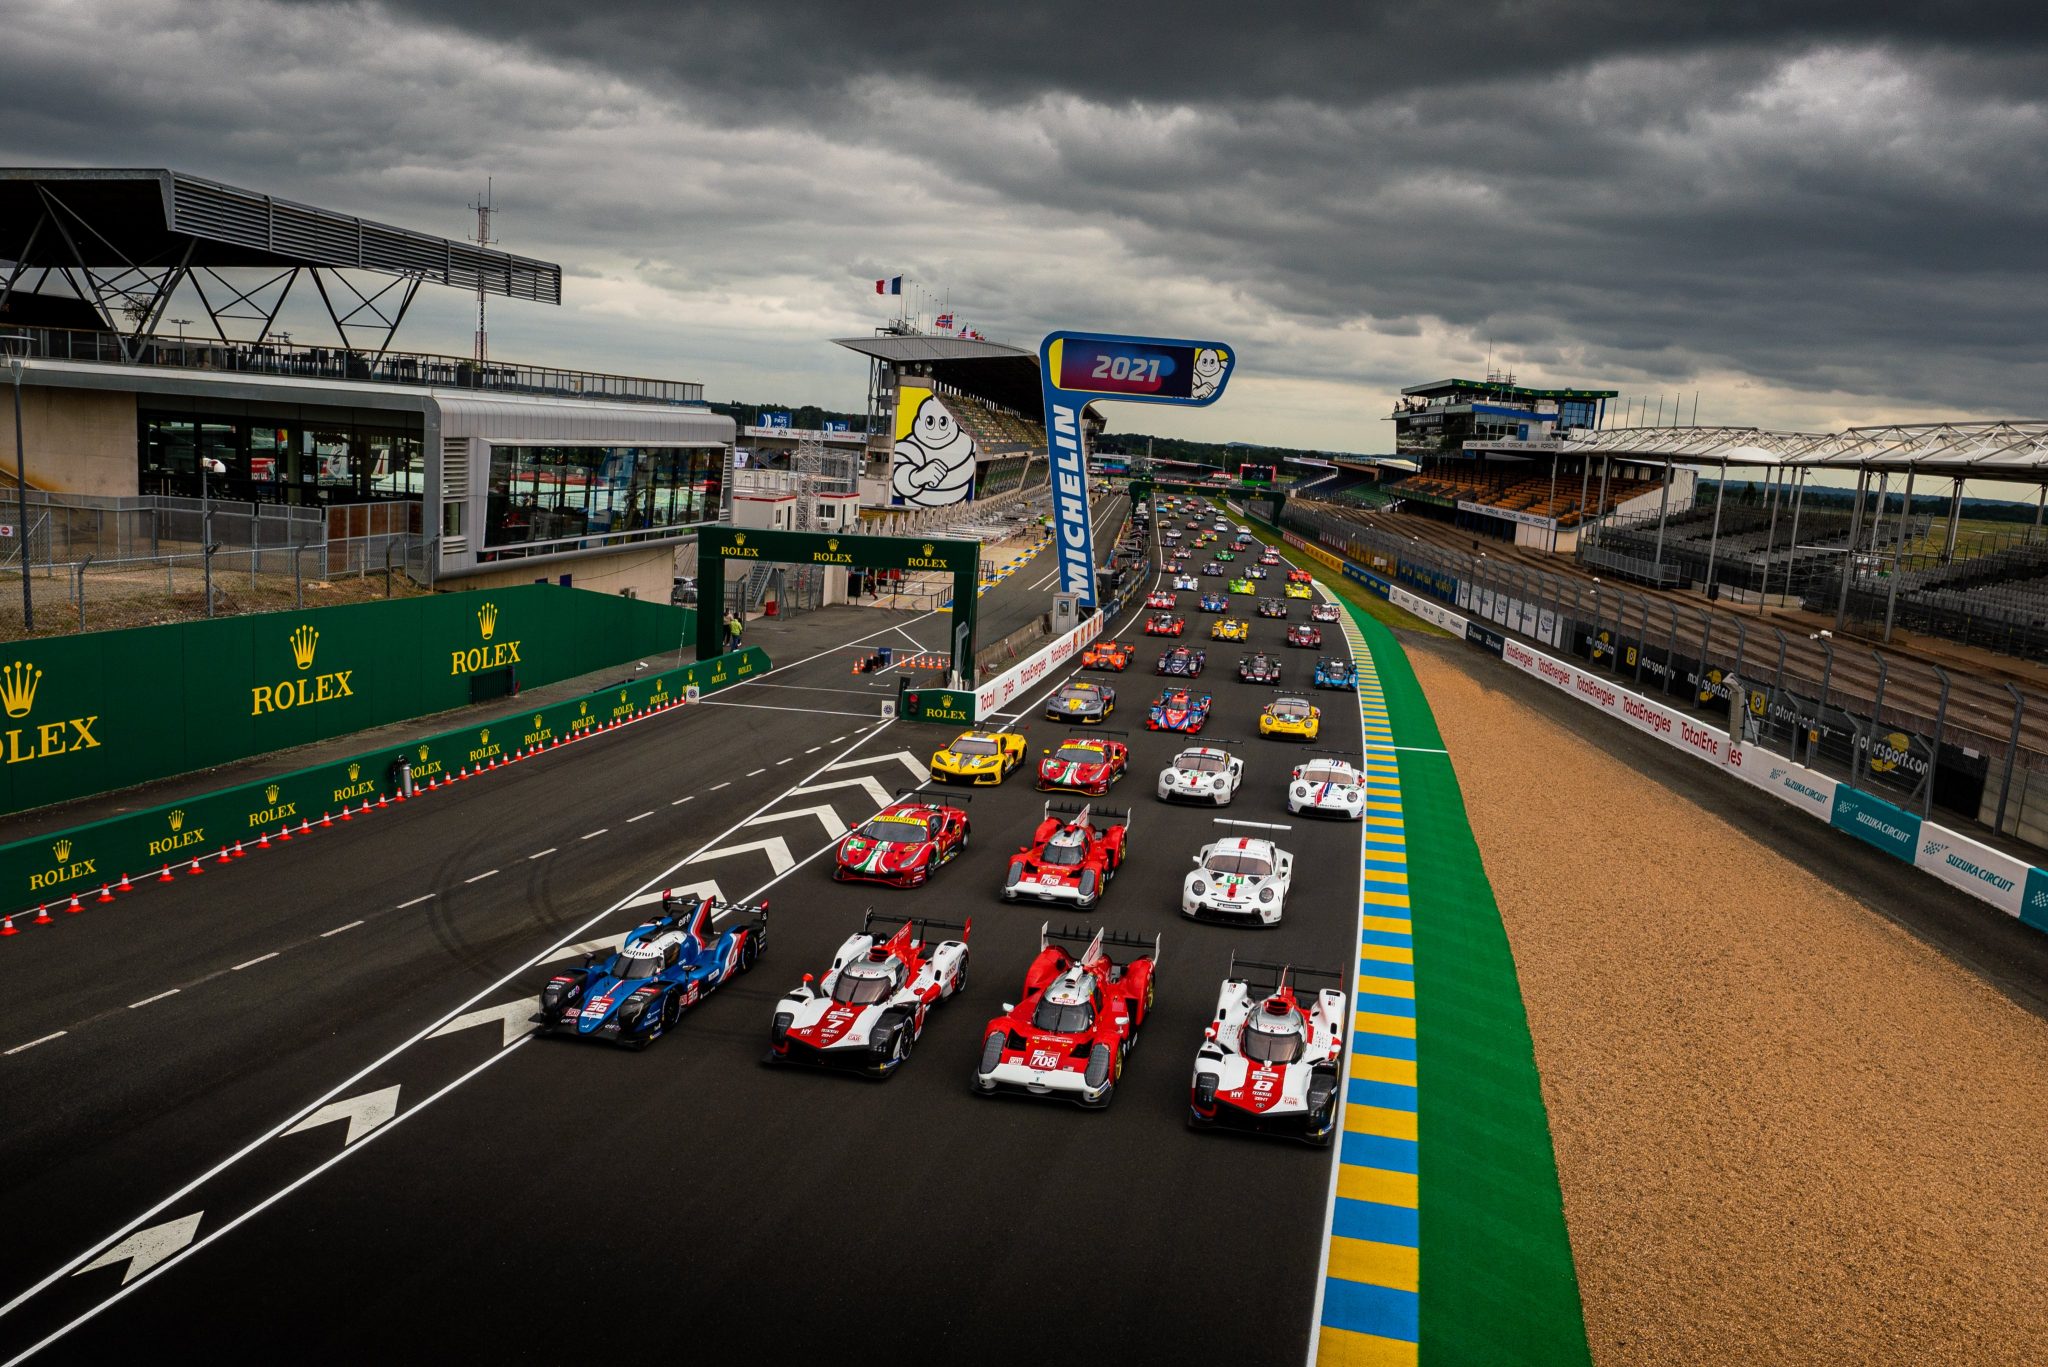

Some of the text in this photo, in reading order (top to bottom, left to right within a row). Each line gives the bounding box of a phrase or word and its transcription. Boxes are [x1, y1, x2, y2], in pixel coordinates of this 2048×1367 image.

[1092, 355, 1160, 383] 2021
[1053, 404, 1090, 601] MICHELIN
[721, 547, 759, 558] ROLEX
[813, 552, 852, 563] ROLEX
[908, 557, 948, 568] ROLEX
[451, 640, 521, 676] ROLEX
[1506, 643, 1533, 668] TotalEnergies
[1537, 658, 1570, 685] TotalEnergies
[251, 671, 353, 716] ROLEX
[1577, 675, 1616, 706] TotalEnergies
[571, 714, 595, 731] ROLEX
[613, 703, 634, 718] ROLEX
[926, 708, 966, 720] ROLEX
[1623, 695, 1672, 733] TotalEnergies
[0, 715, 101, 764] LEX
[524, 728, 552, 746] ROLEX
[1681, 721, 1743, 767] TotalEneies
[469, 742, 501, 762] ROLEX
[409, 760, 442, 779] ROLEX
[333, 780, 375, 802] ROLEX
[1784, 777, 1828, 804] SUZUKA CIRCUIT
[249, 802, 296, 828] ROLEX
[1856, 811, 1911, 844] SUZUKA CIRCUIT
[149, 828, 205, 856] ROLEX
[29, 858, 96, 891] ROLEX
[1042, 877, 1059, 885] 709
[1946, 854, 2015, 892] SUZUKA CIRCUIT
[586, 1001, 609, 1014] 36
[828, 1019, 845, 1029] 7
[1032, 1055, 1056, 1068] 708
[1253, 1081, 1274, 1090] 8
